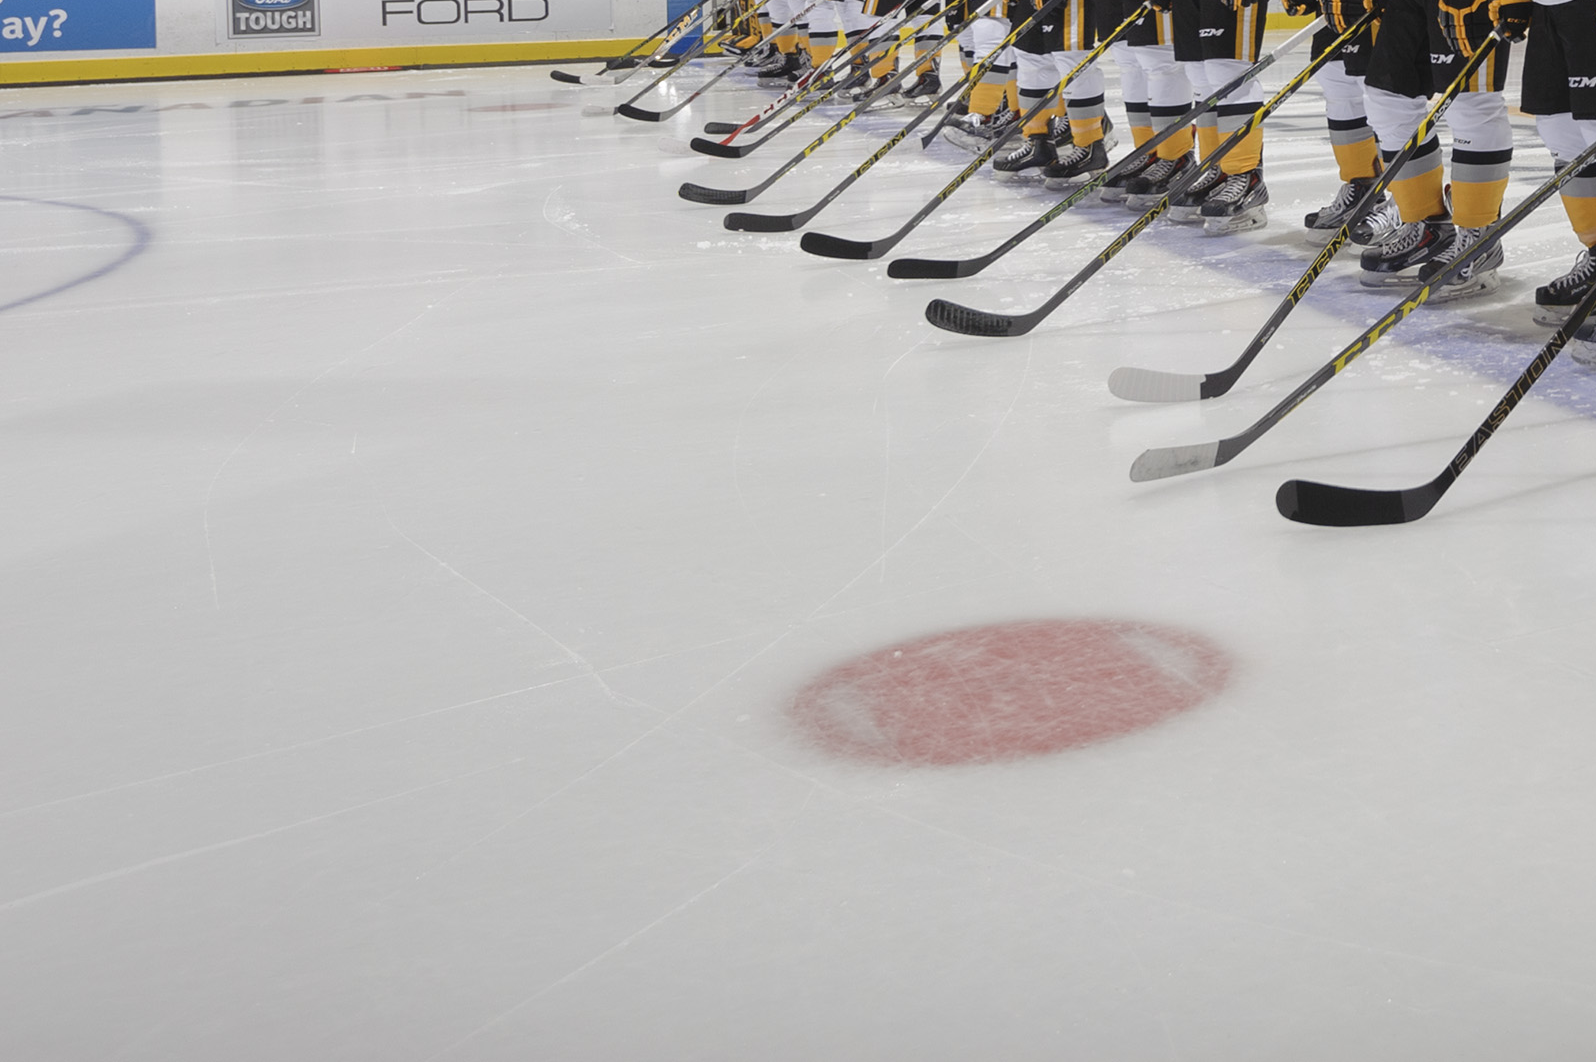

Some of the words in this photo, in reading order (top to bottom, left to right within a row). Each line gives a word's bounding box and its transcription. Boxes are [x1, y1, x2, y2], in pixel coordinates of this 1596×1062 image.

[236, 12, 312, 31] TOUGH
[1332, 285, 1430, 376] CCM
[1449, 326, 1567, 479] EASTON
